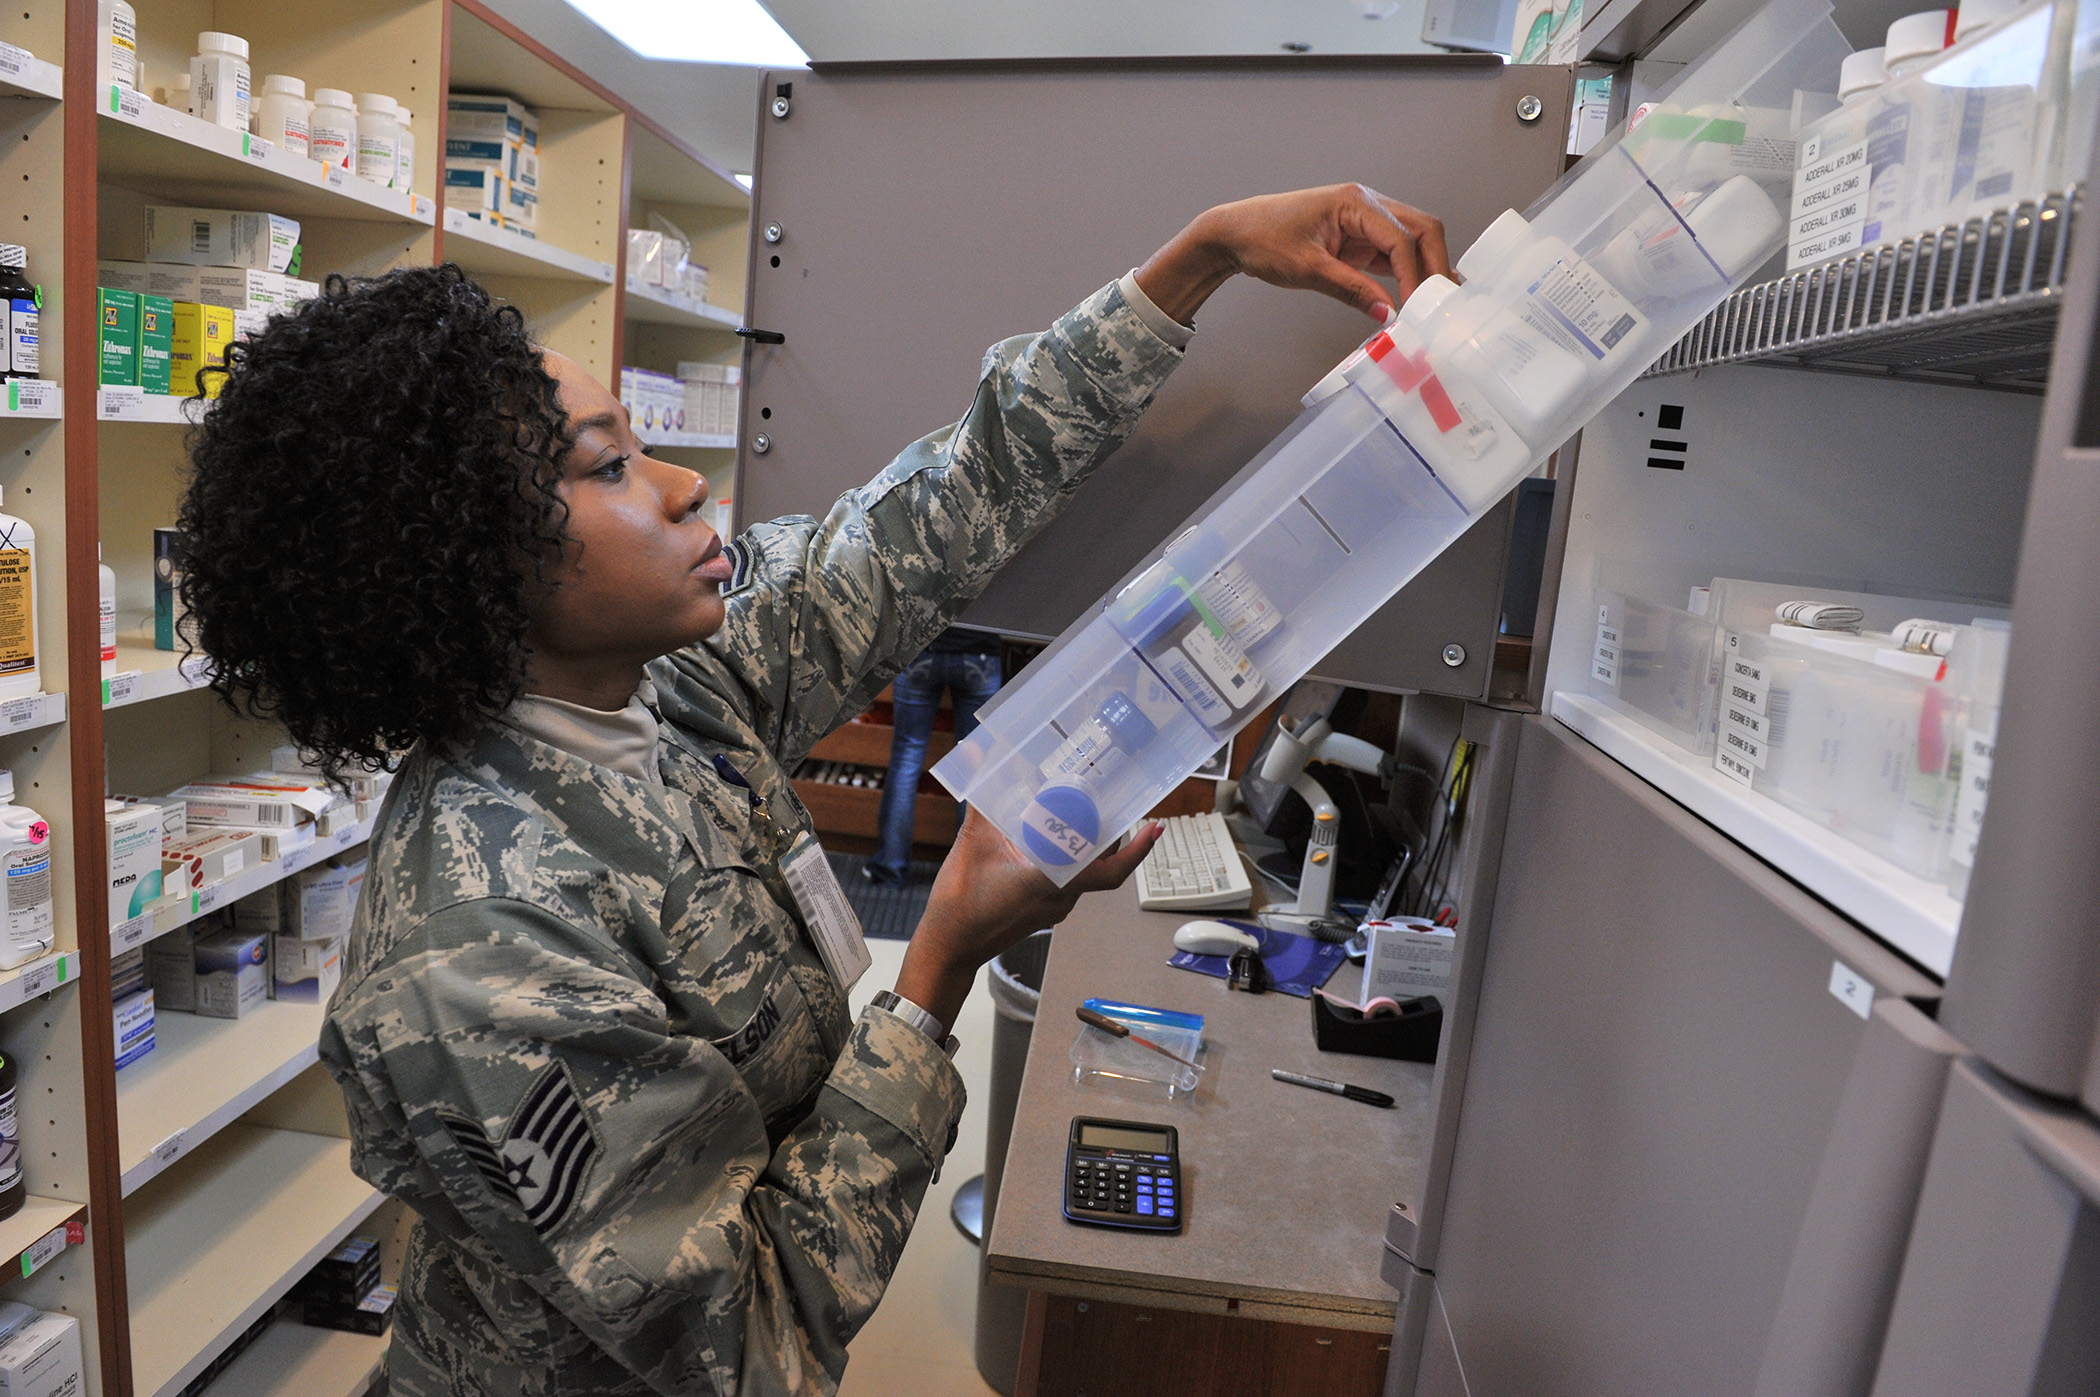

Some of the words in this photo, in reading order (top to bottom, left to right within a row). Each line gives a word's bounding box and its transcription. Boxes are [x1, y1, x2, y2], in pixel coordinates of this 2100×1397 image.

[1808, 144, 1816, 156] 2
[1805, 162, 1834, 182] ADDERALL
[1836, 156, 1846, 169] XR
[1845, 148, 1863, 166] 20MG
[1802, 189, 1831, 208] ADDERALL
[1832, 184, 1842, 197] XR
[1842, 176, 1859, 193] 25MG
[1800, 216, 1828, 235] ADDERALL
[1830, 211, 1838, 223] XR
[1839, 203, 1856, 219] 30MG
[1798, 242, 1827, 259] ADDERALL
[1828, 236, 1837, 249] XR
[1838, 232, 1852, 246] 5MG
[1579, 320, 1588, 328] 10
[1586, 310, 1599, 321] mg
[1730, 636, 1737, 647] 5
[113, 874, 136, 887] MEDA
